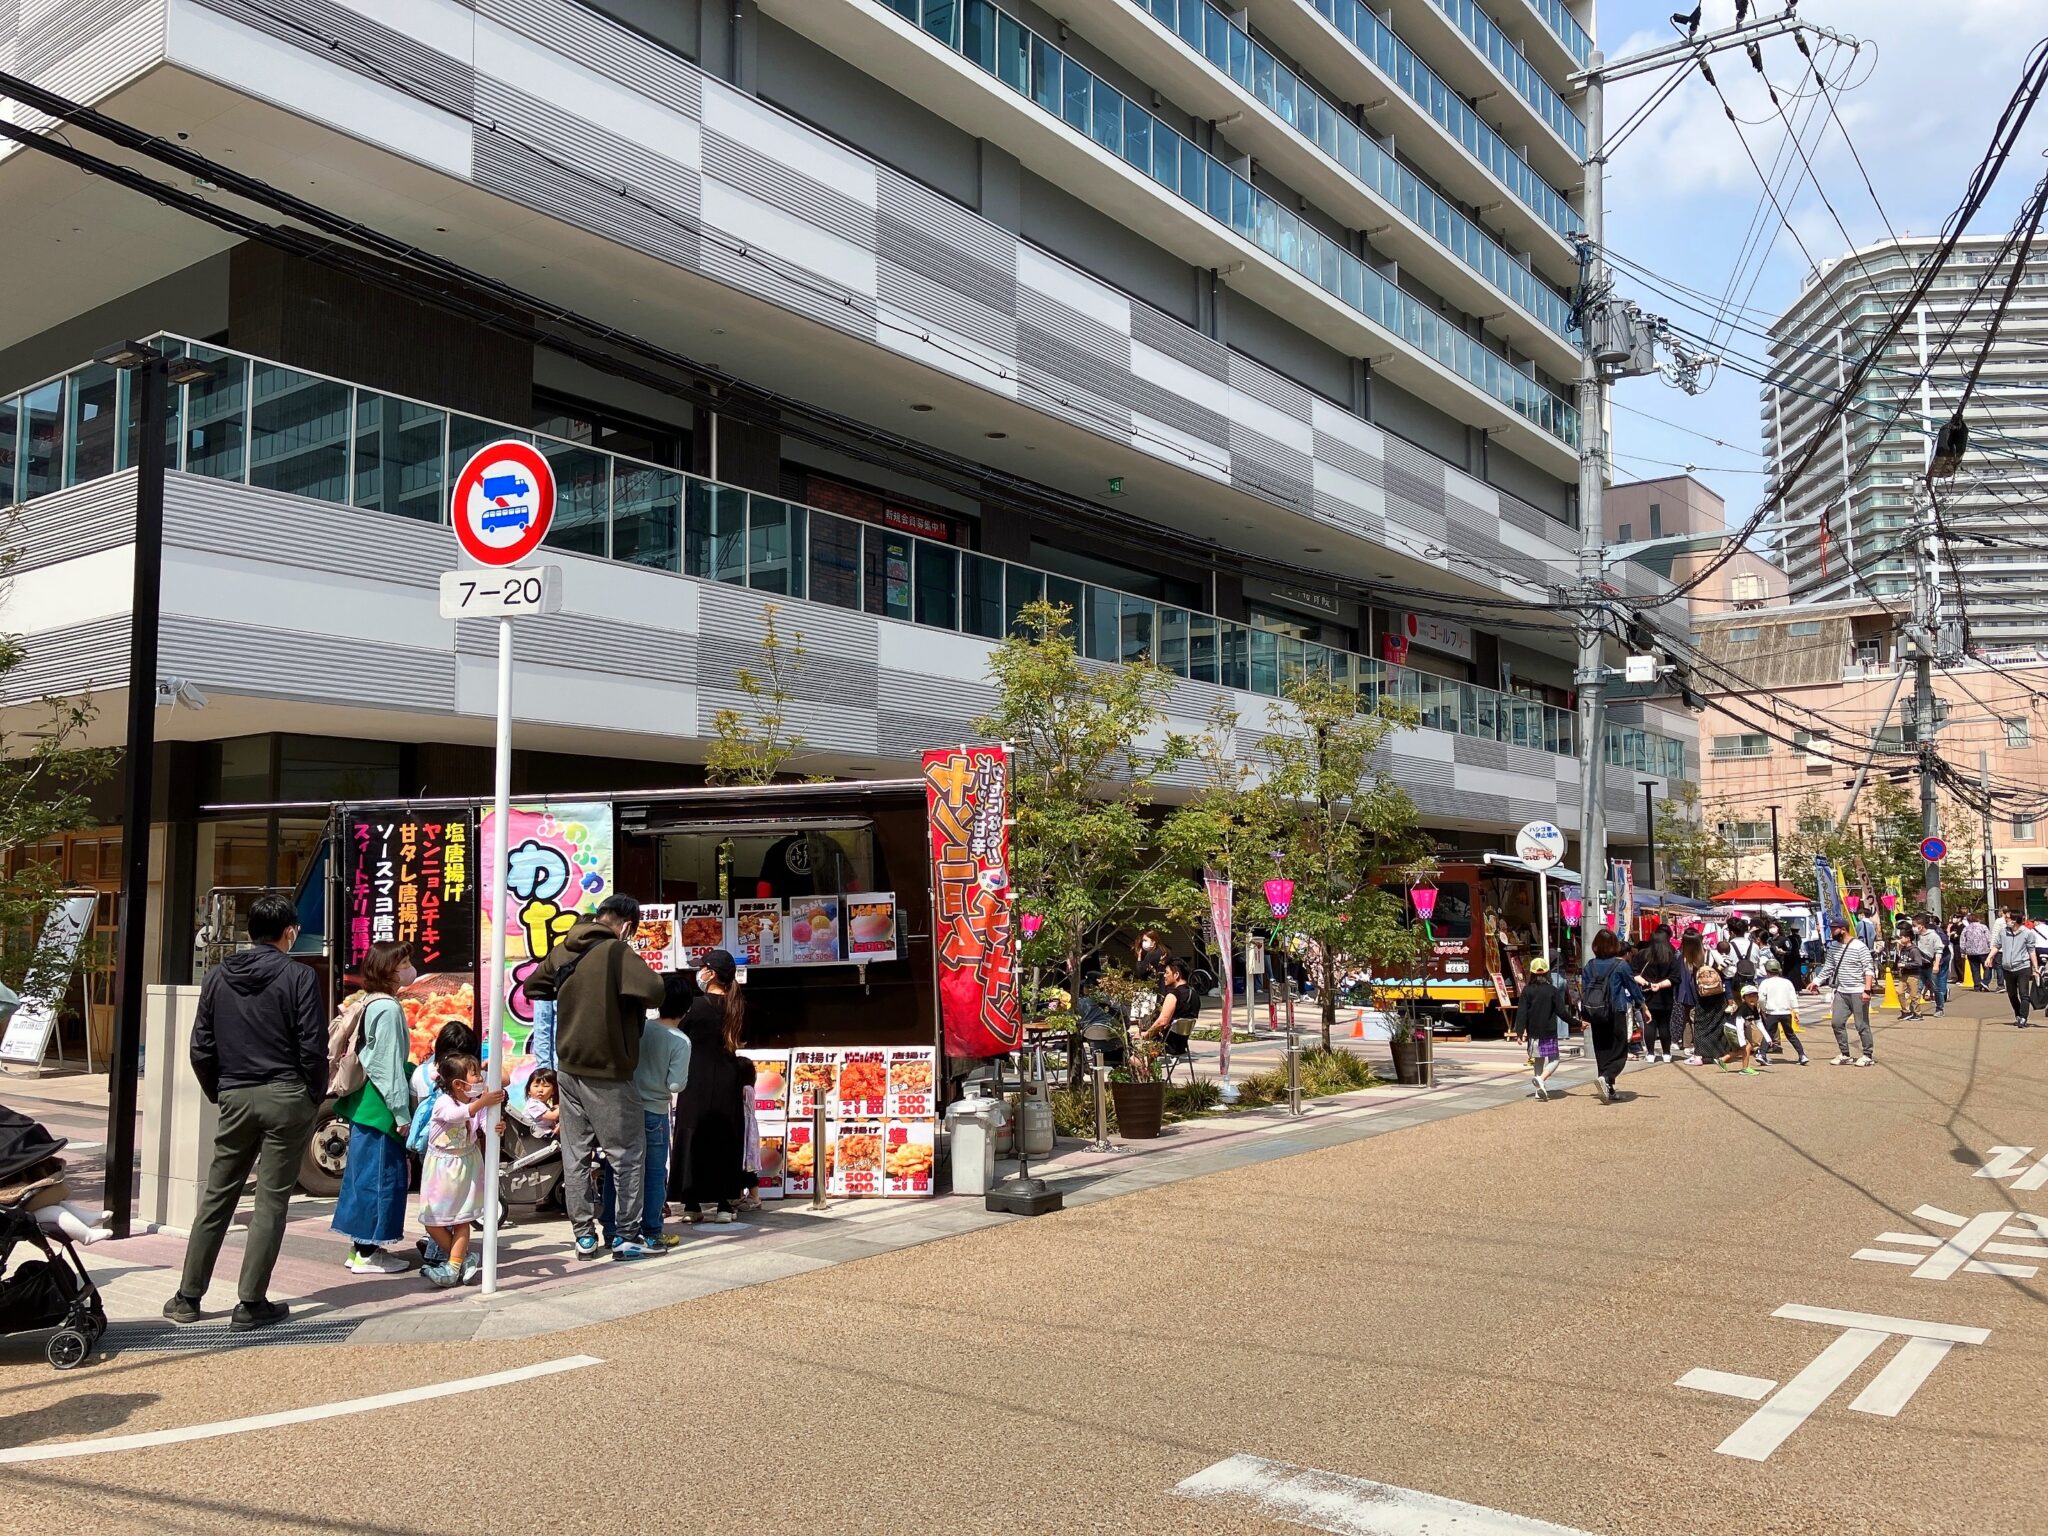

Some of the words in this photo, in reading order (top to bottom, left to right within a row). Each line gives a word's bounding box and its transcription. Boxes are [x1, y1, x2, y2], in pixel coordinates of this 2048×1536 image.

[459, 577, 542, 607] 7-20
[444, 823, 465, 902] 塩唐揚げ
[398, 823, 418, 942] 甘タレ唐揚げ
[421, 823, 441, 964] ヤンニョムチキン
[796, 1052, 837, 1063] 唐揚げ
[898, 1095, 925, 1104] 500
[898, 1105, 925, 1114] 800
[845, 1173, 874, 1182] 500
